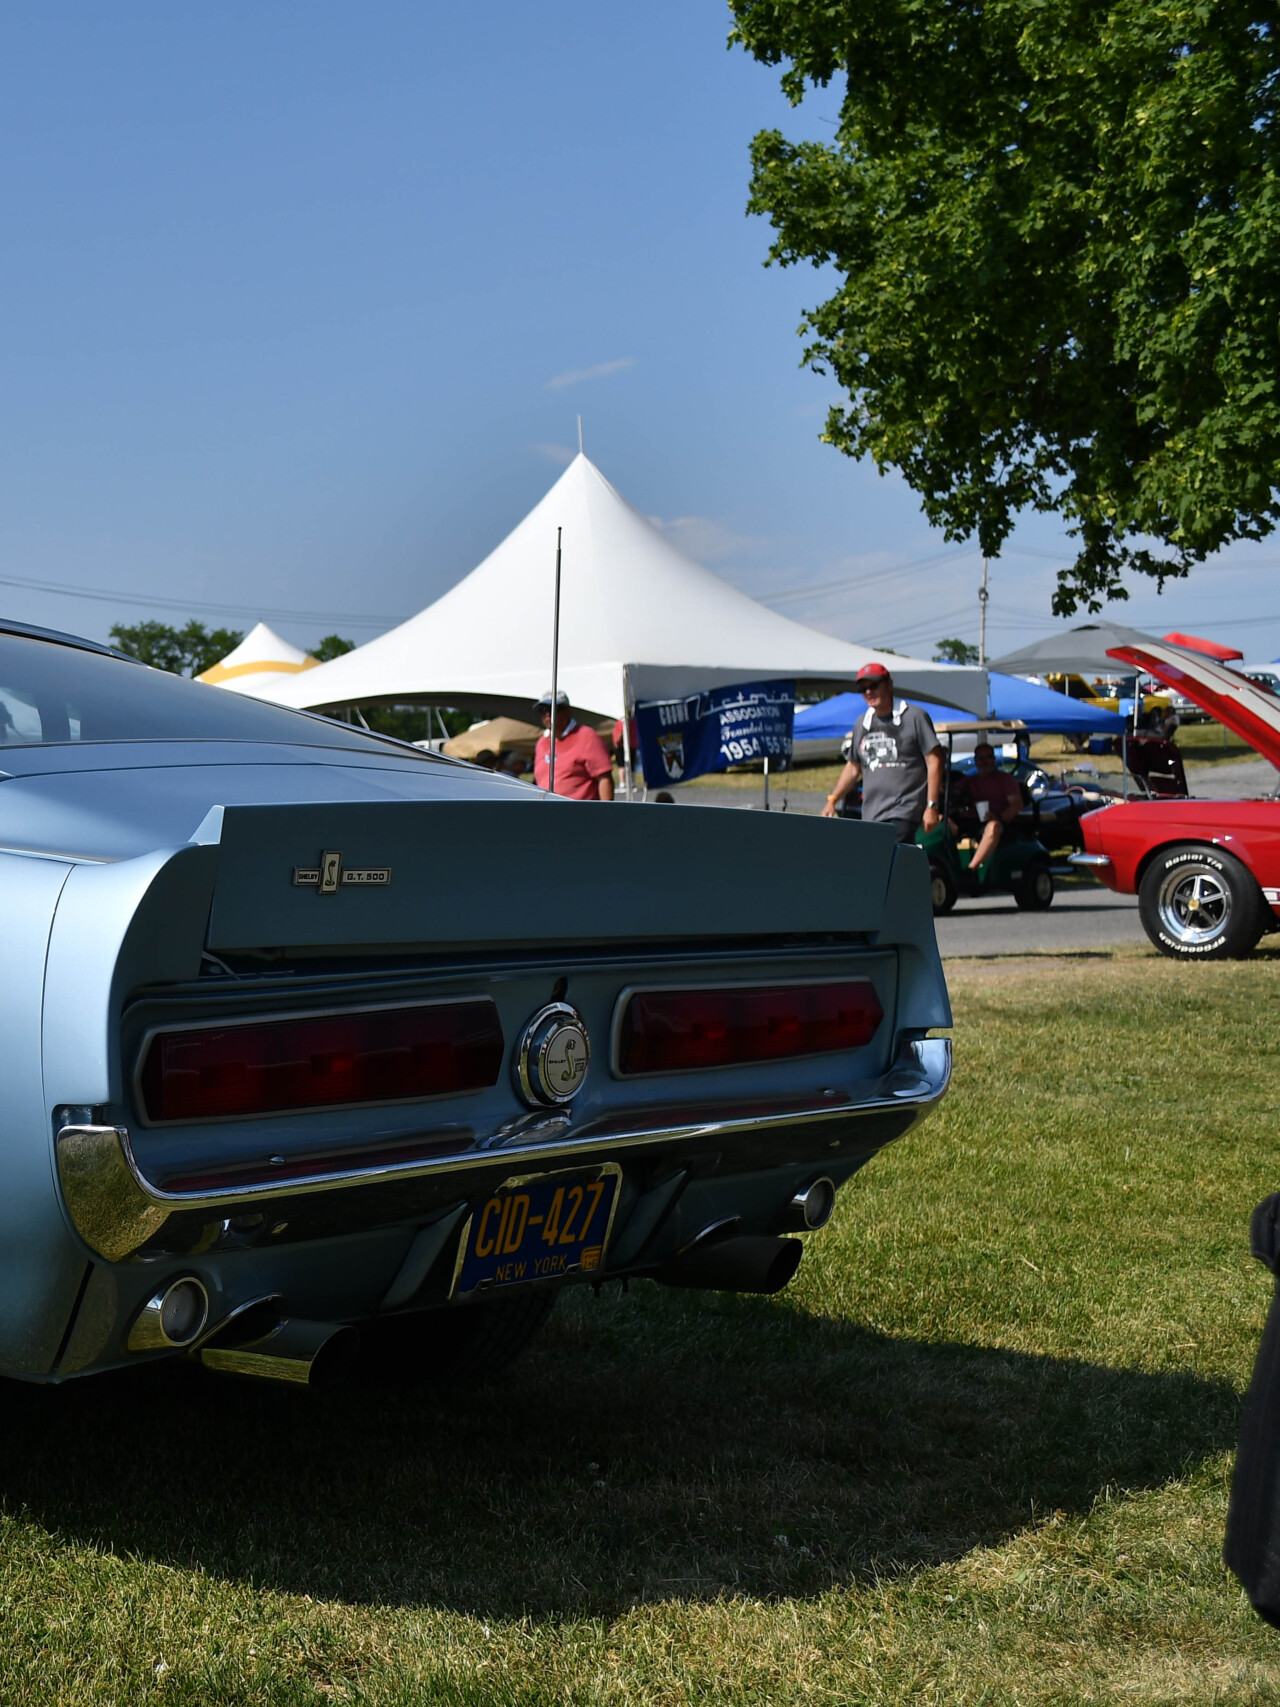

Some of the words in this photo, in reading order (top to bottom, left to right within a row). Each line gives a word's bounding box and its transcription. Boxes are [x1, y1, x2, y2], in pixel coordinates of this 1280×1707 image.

[720, 705, 780, 725] ASSOCIATION
[721, 723, 763, 741] Founded
[721, 737, 762, 762] 1954
[1165, 853, 1203, 869] Radial
[475, 1181, 605, 1258] CID-427
[495, 1261, 527, 1282] NEW
[534, 1254, 568, 1274] YORK
